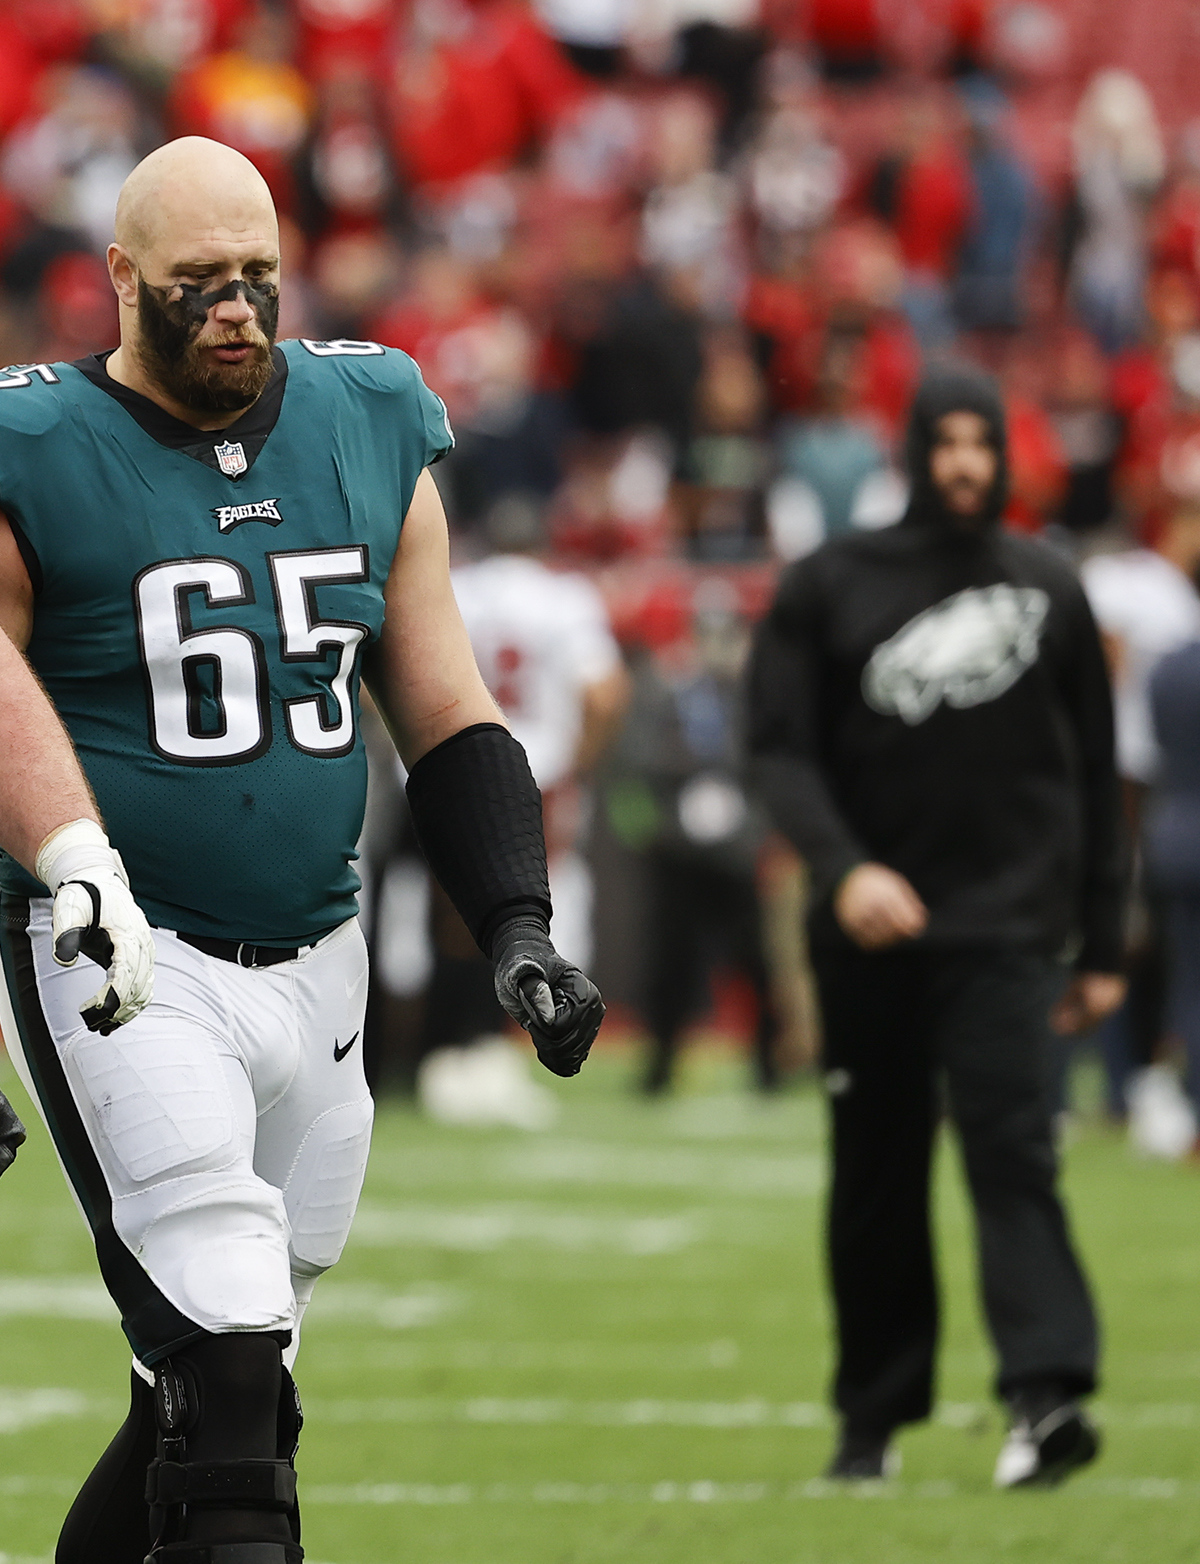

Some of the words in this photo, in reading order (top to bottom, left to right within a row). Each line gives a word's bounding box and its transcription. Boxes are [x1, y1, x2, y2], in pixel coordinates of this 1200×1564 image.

[222, 455, 243, 470] NFL
[212, 498, 284, 532] EAGLES
[133, 544, 371, 767] 65
